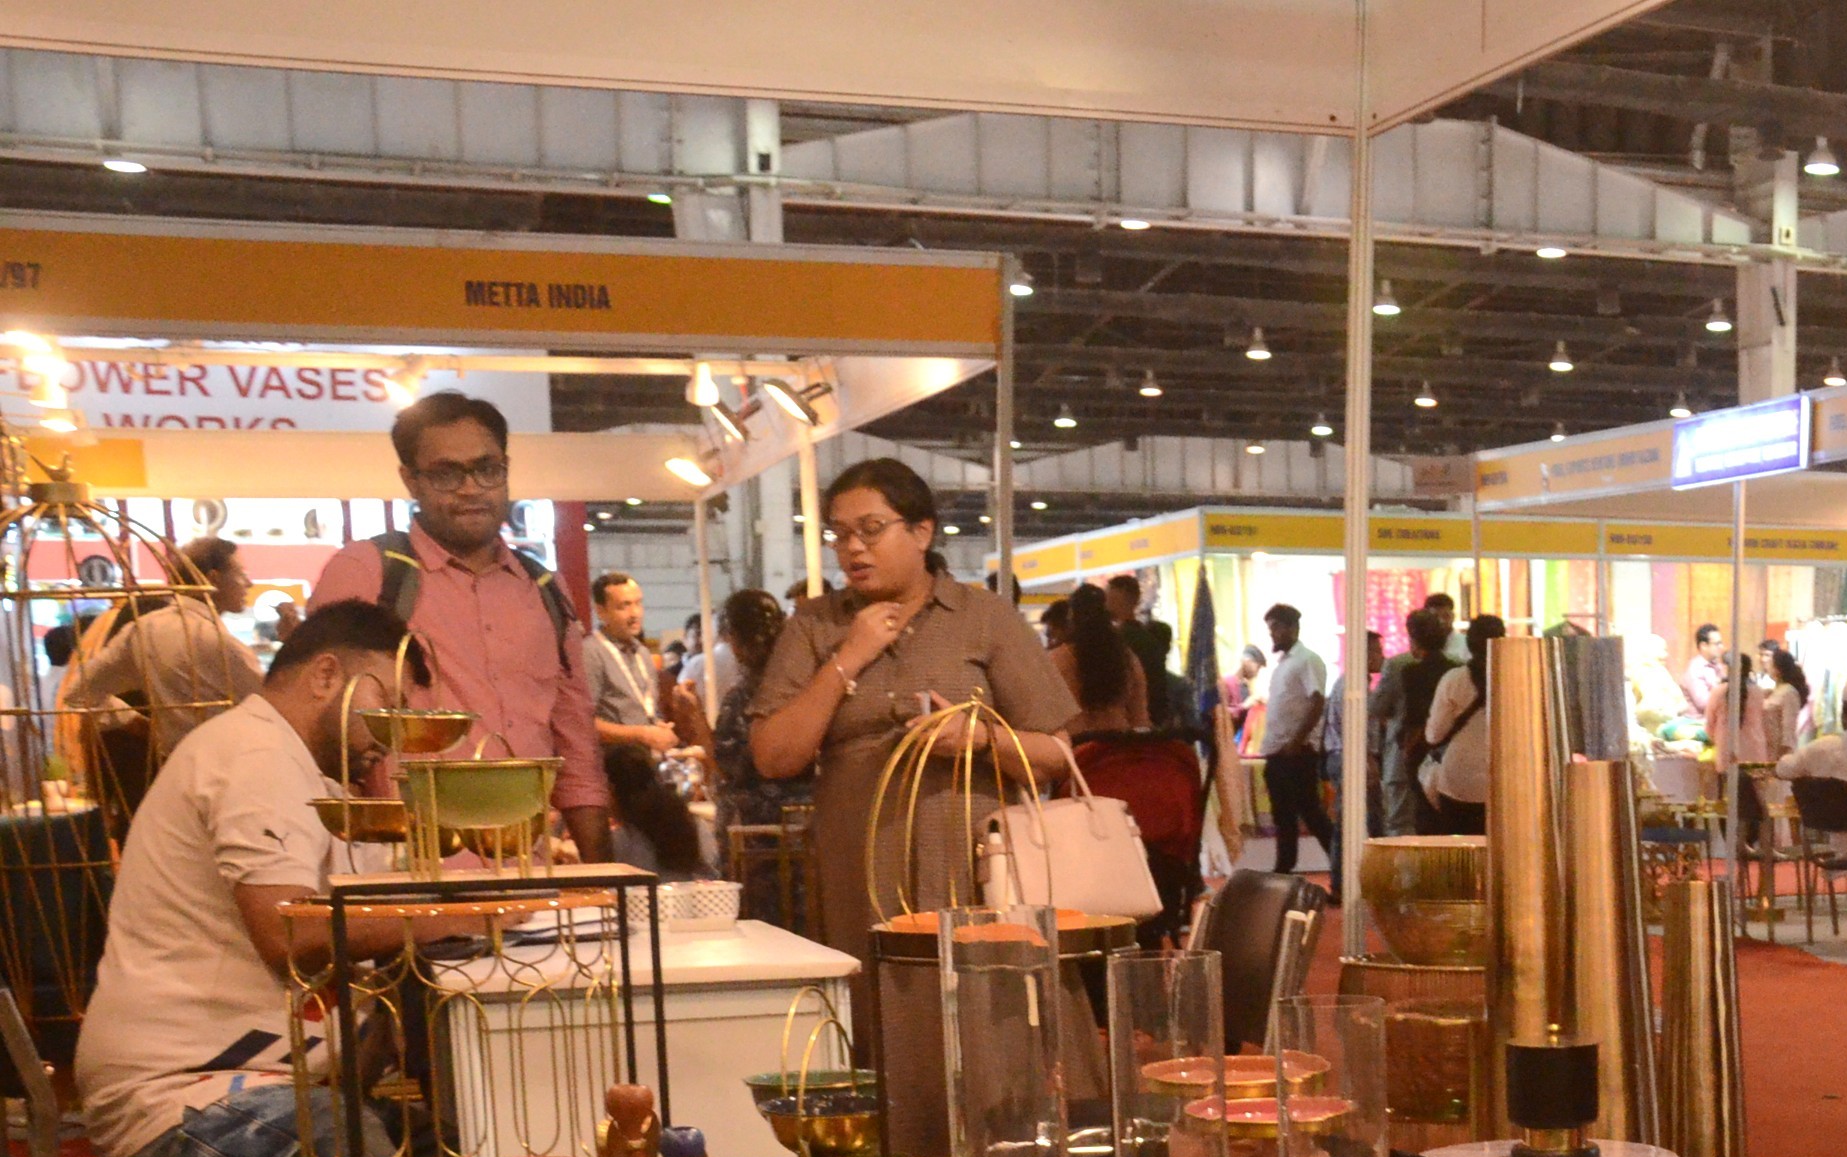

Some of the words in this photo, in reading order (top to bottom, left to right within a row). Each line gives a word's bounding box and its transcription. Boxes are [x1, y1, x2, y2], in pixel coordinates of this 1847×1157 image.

[465, 280, 540, 307] METTA
[548, 283, 612, 310] INDIA
[0, 360, 210, 398] LOWER
[225, 364, 391, 402] VASES
